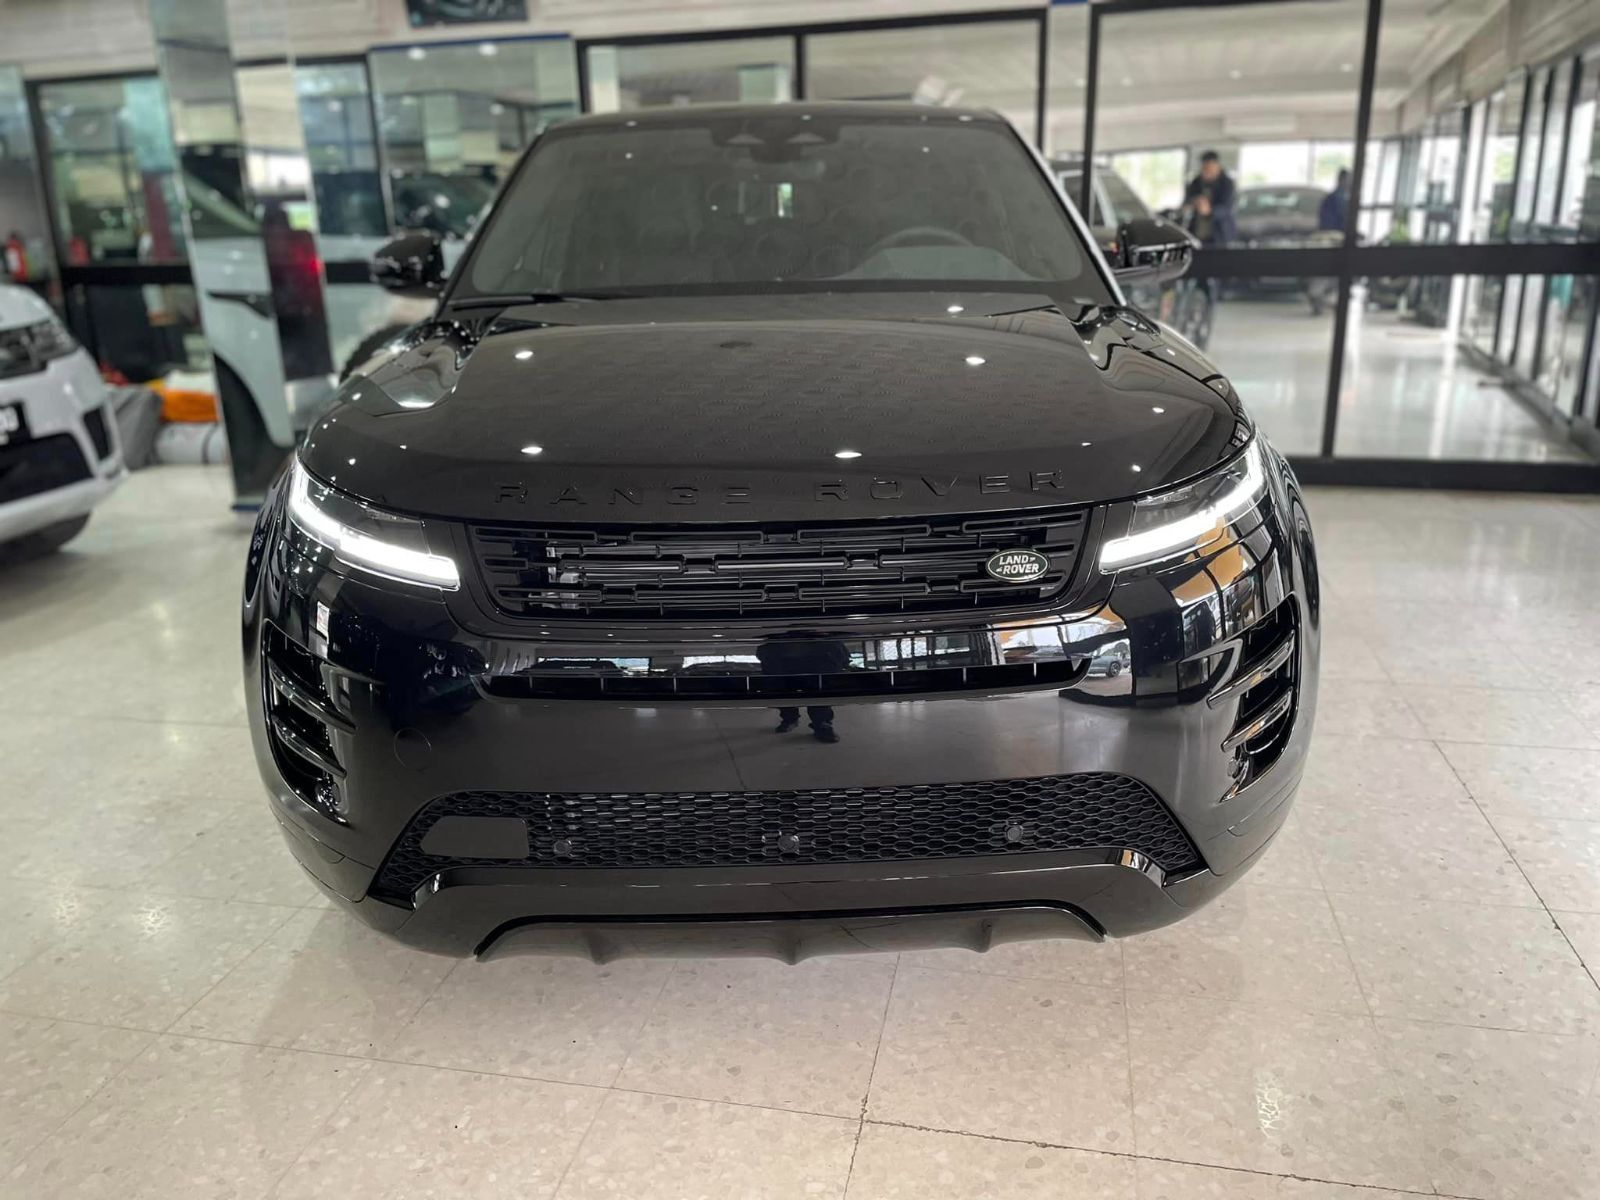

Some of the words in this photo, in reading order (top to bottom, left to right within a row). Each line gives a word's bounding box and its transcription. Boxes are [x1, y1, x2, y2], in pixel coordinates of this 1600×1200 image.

[496, 483, 752, 505] RANGE
[815, 468, 1065, 501] ROVER
[999, 555, 1029, 565] LAND
[1002, 563, 1040, 575] ROVER
